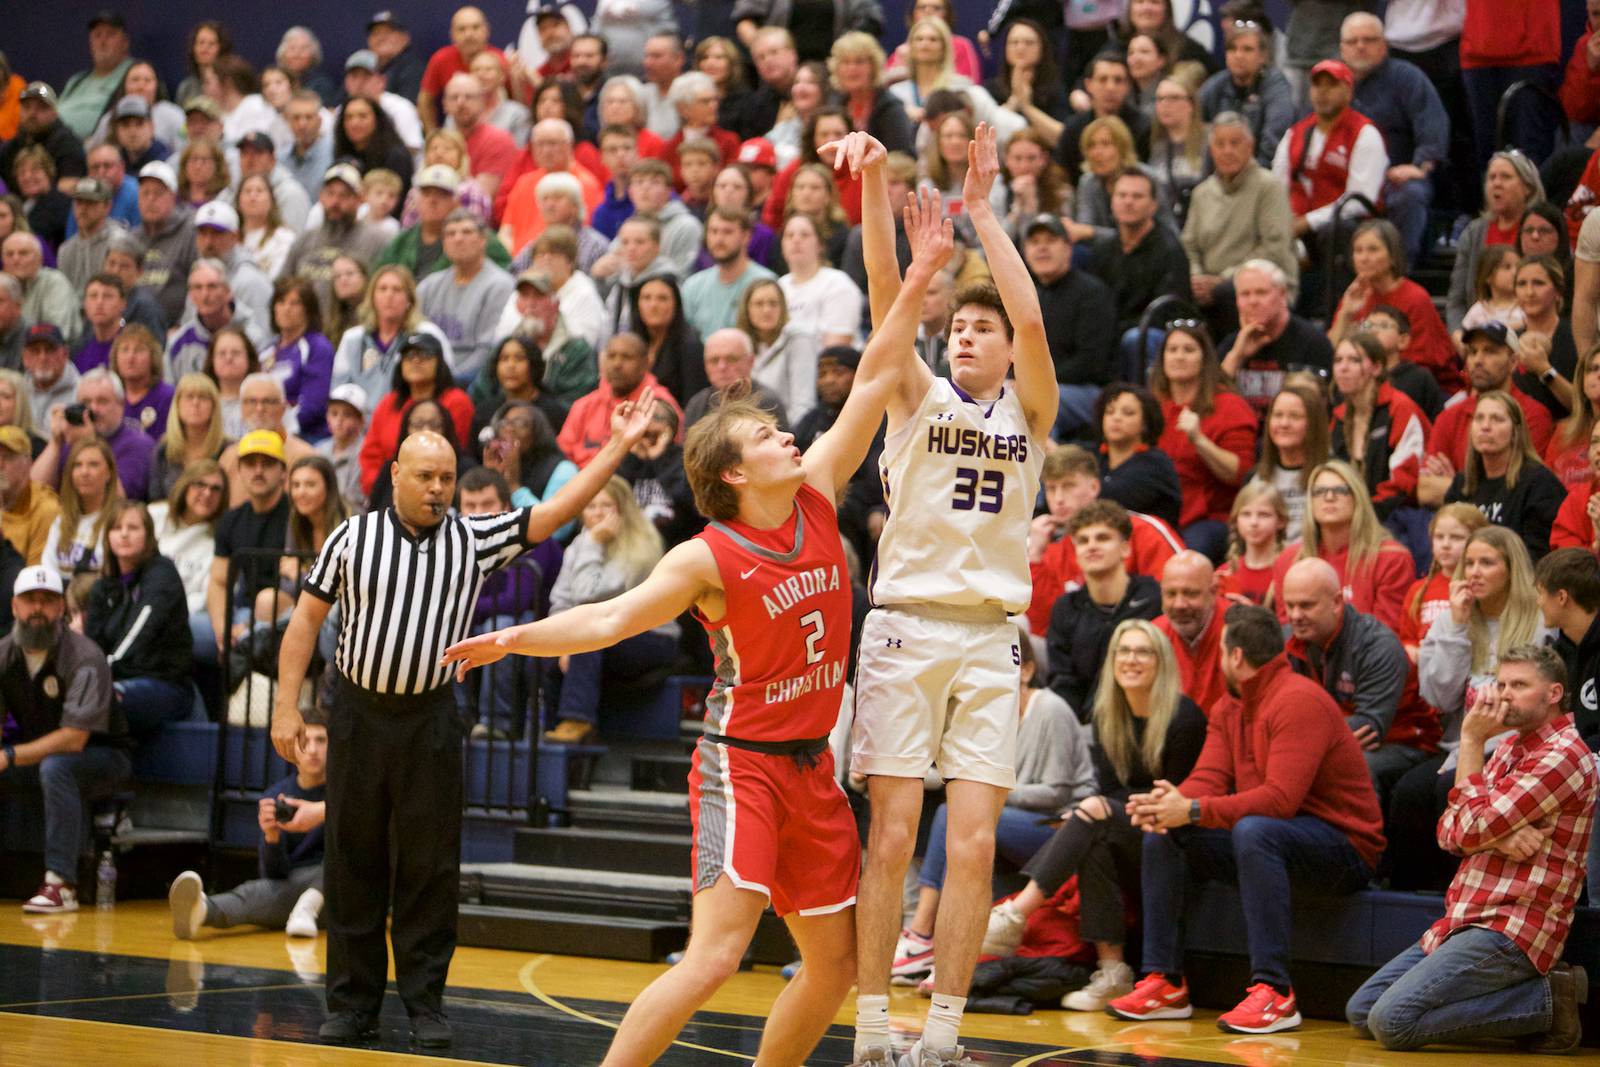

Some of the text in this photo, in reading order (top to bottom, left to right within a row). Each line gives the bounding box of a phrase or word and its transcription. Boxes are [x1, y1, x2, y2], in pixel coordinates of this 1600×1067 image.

[928, 425, 1028, 463] HUSKERS
[952, 467, 1005, 514] 33
[762, 564, 840, 620] AURORA
[799, 609, 826, 665] 2
[1011, 644, 1020, 666] S
